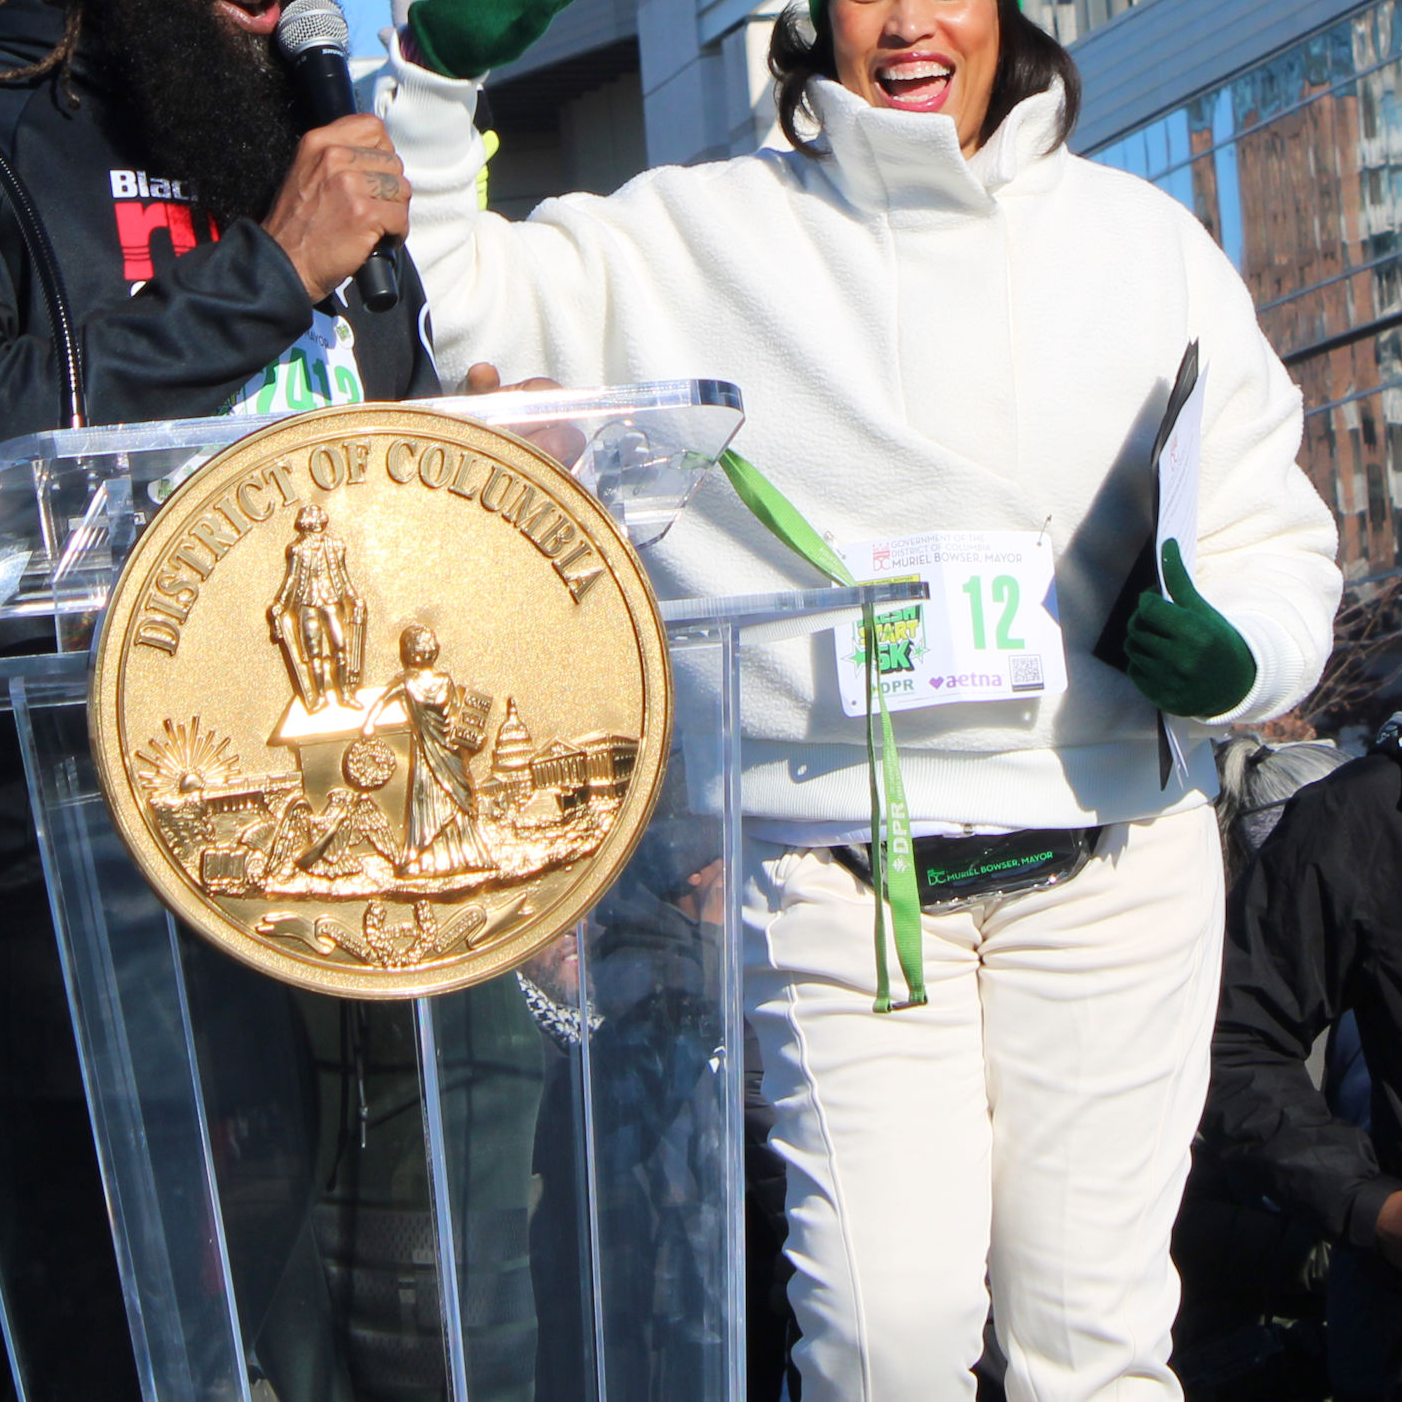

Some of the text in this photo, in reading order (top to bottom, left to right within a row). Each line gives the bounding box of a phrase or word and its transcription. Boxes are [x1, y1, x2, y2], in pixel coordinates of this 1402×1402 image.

[109, 169, 198, 201] Blac
[135, 438, 607, 657] DISTRICT OF COLUMBIA
[891, 544, 928, 558] DISTRICT
[930, 543, 943, 552] OF
[892, 552, 1022, 569] MURIEL BOWSER, MAYOR
[962, 574, 1026, 650] 12
[881, 678, 914, 695] DPR
[946, 672, 1002, 689] aetna
[891, 802, 910, 855] DPR
[947, 868, 980, 882] MURIEL
[980, 859, 1021, 874] BOWSER,
[1022, 850, 1054, 865] MAYOR
